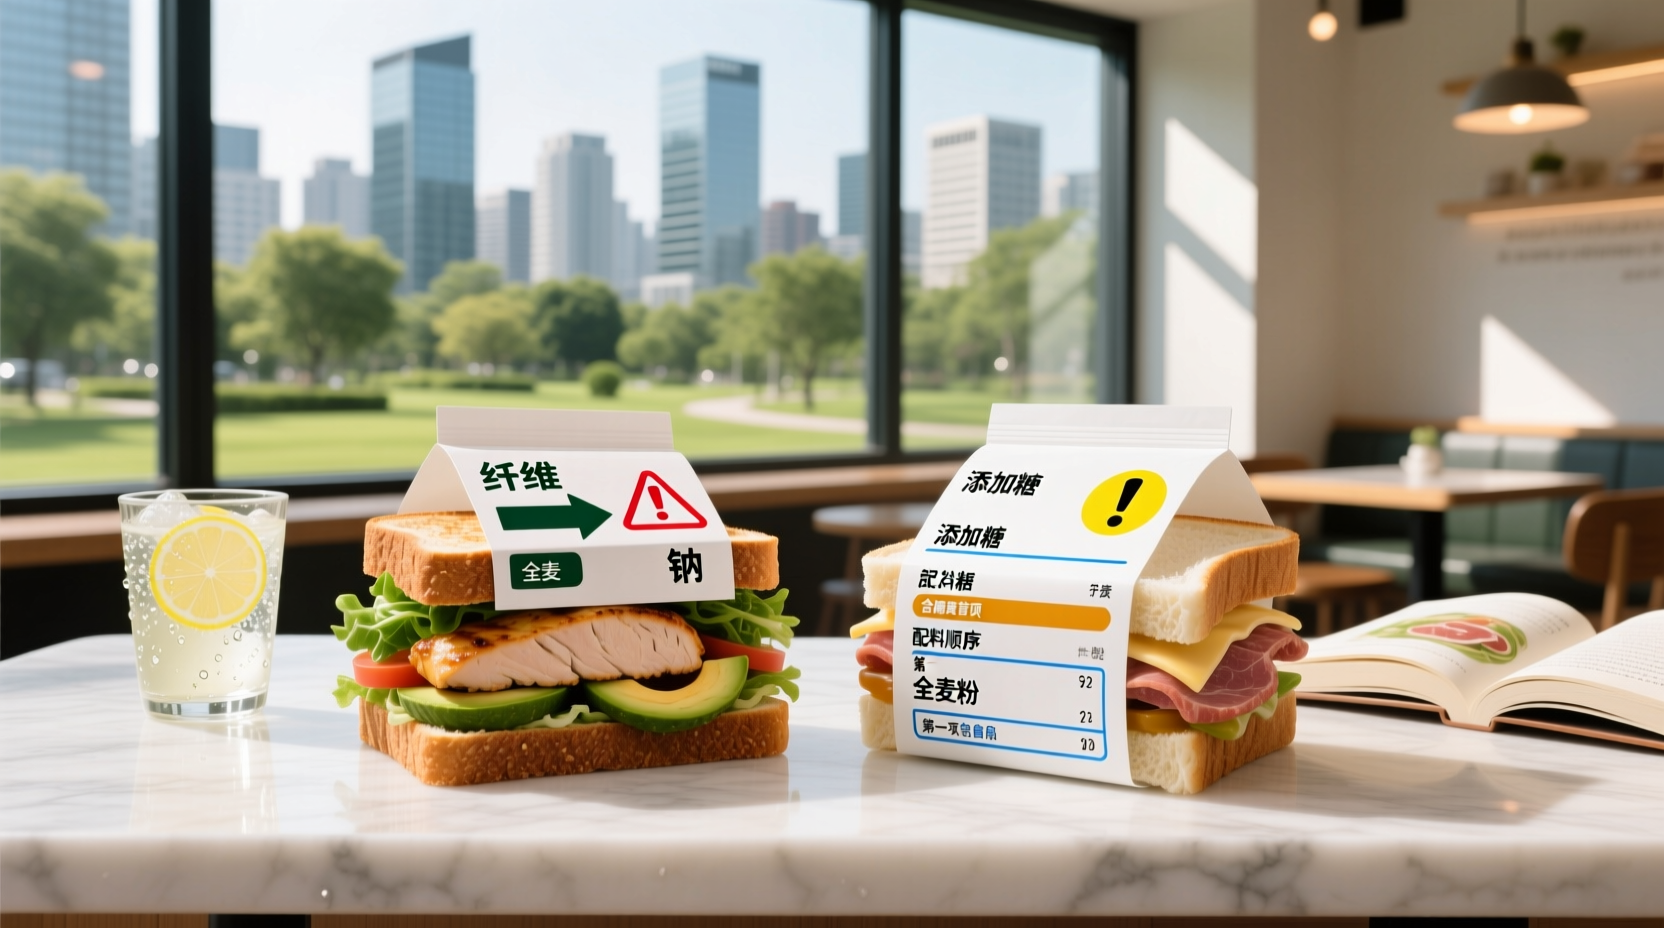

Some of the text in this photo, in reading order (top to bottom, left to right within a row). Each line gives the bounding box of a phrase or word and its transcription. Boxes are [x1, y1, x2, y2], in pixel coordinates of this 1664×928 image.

[480, 461, 562, 492] 纤维
[962, 470, 1044, 497] 添加糖
[934, 523, 1007, 549] 添加糖
[522, 560, 561, 582] 全麦
[667, 547, 704, 584] 钠
[913, 675, 980, 706] 全麦粉
